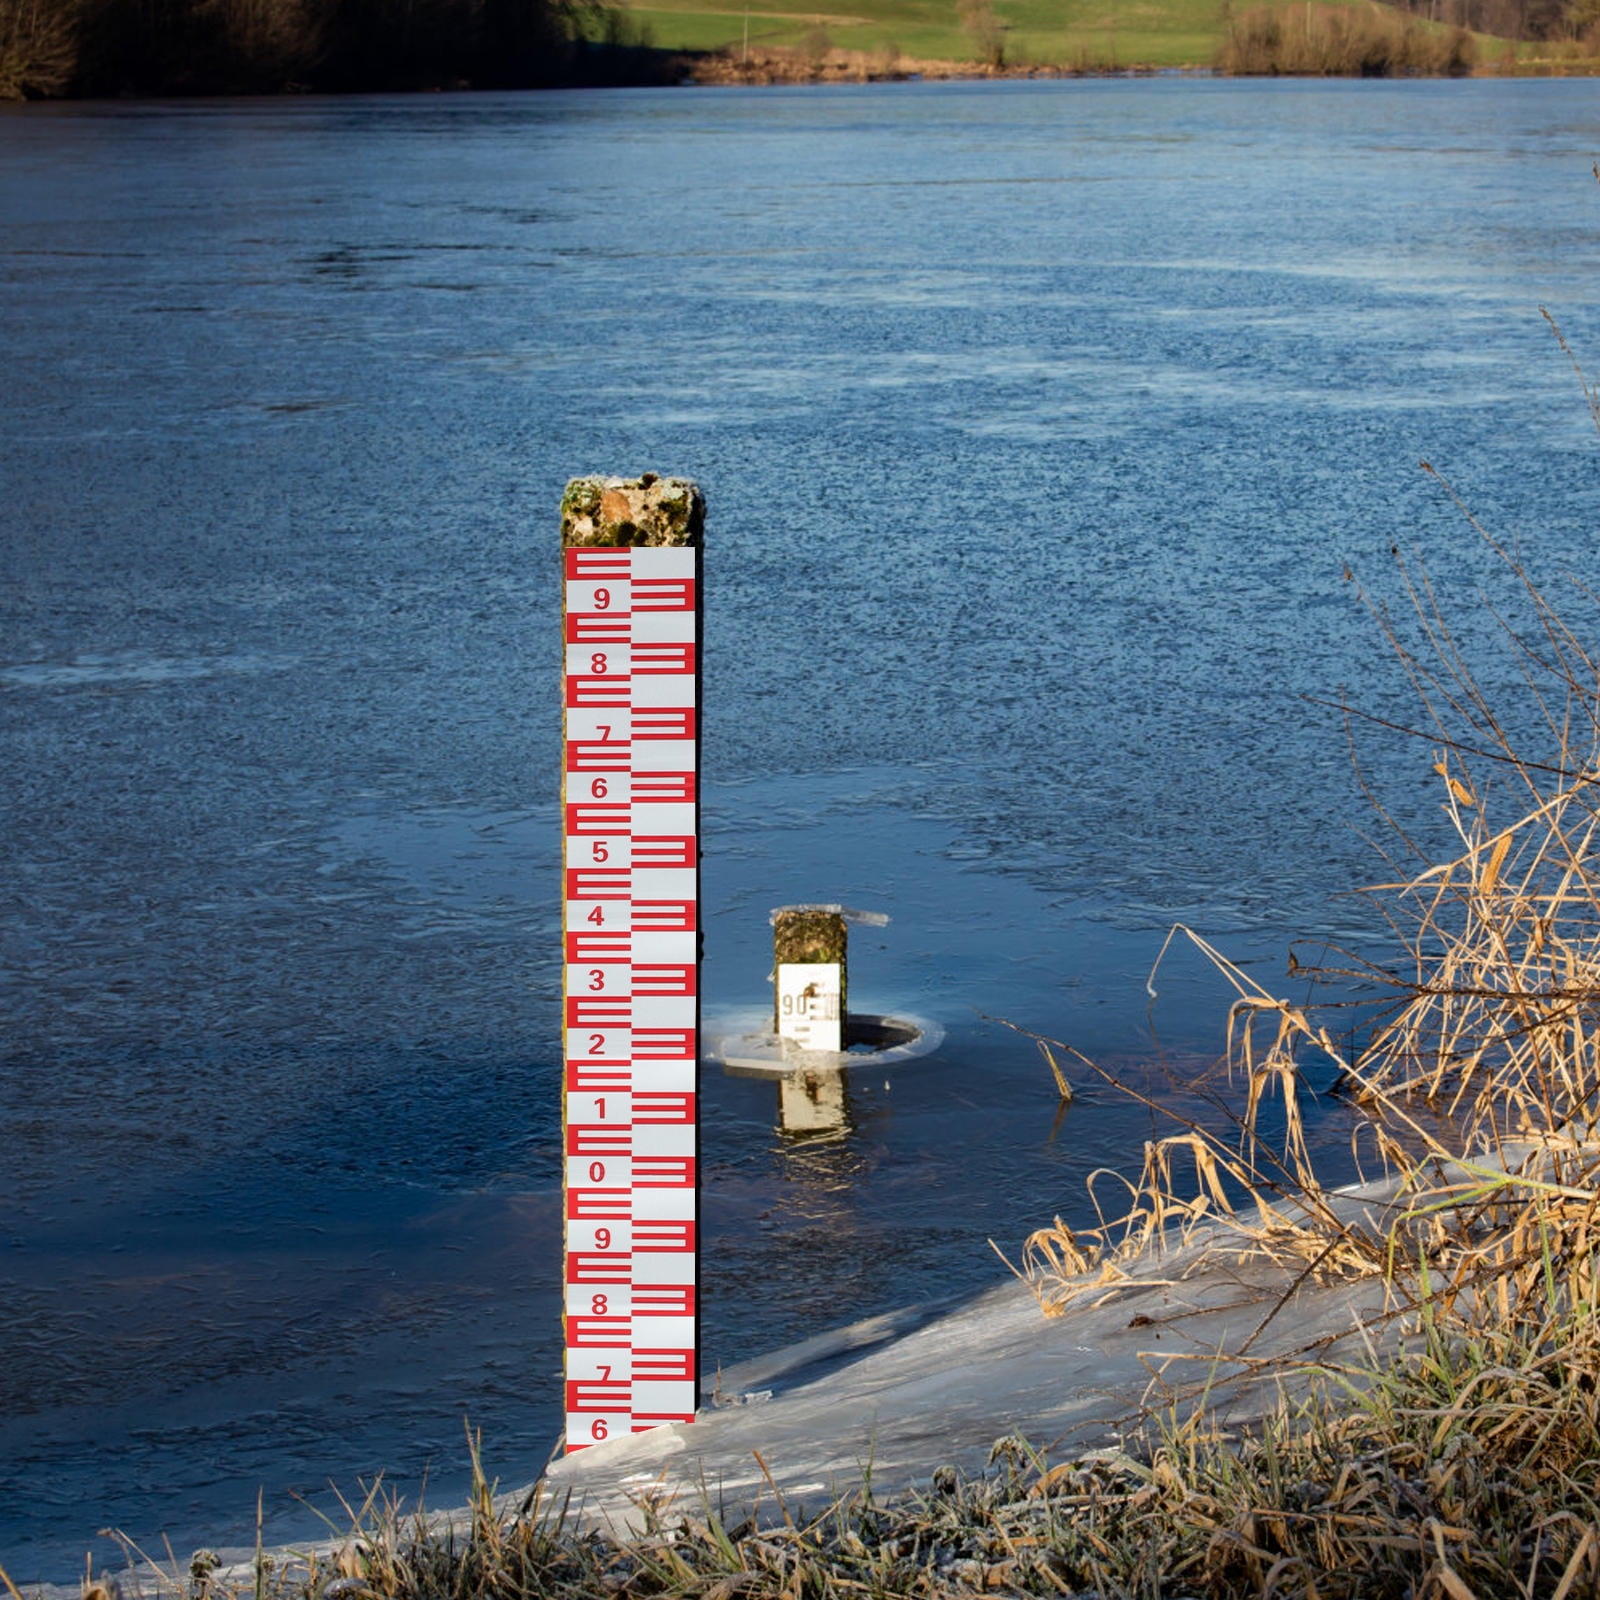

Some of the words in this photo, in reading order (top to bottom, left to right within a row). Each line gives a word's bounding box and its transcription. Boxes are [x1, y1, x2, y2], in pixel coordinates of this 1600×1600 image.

[593, 587, 611, 610] 9
[590, 652, 608, 675] 8
[595, 725, 612, 744] 7
[591, 777, 608, 799] 6
[592, 840, 609, 863] 5
[587, 905, 605, 926] 4
[588, 968, 605, 991] 3
[782, 993, 808, 1017] 90
[588, 1033, 606, 1055] 2
[594, 1097, 606, 1119] 1
[588, 1161, 606, 1183] 0
[594, 1227, 612, 1250] 9
[591, 1293, 609, 1316] 8
[595, 1365, 612, 1384] 7
[591, 1418, 609, 1441] 6
